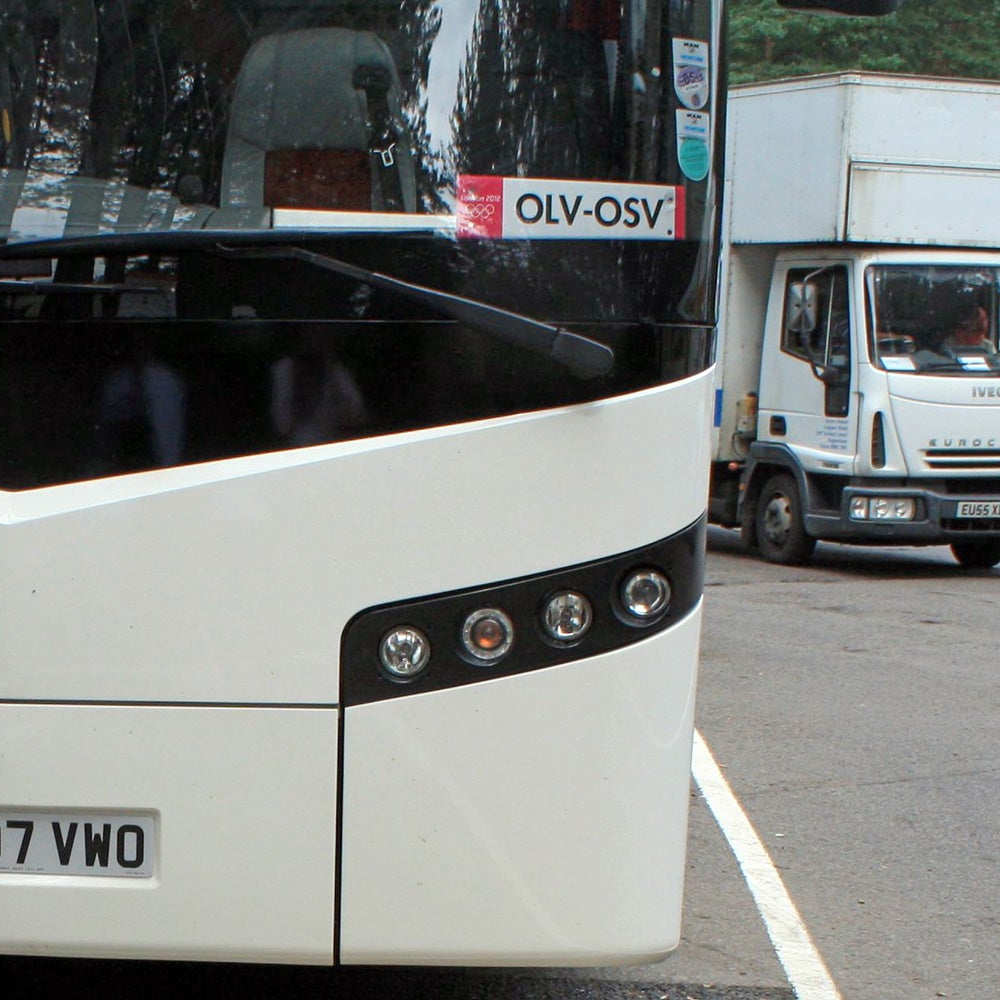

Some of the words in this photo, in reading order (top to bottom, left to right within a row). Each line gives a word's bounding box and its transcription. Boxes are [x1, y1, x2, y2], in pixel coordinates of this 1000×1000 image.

[485, 194, 501, 202] 2012
[516, 192, 665, 229] OLV-OSV
[961, 503, 990, 516] EU55
[51, 821, 146, 869] VWO
